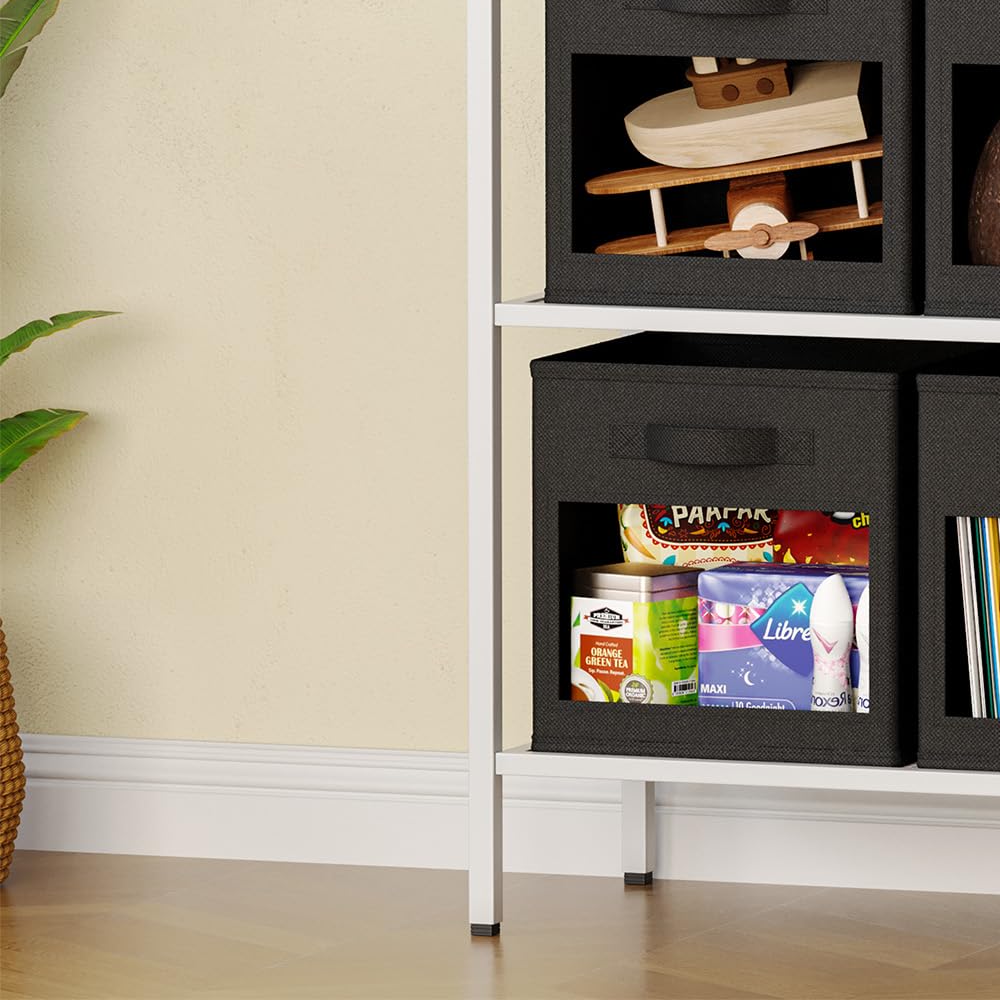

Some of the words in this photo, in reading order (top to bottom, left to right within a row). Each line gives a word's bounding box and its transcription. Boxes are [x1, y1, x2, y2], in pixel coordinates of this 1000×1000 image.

[763, 617, 811, 641] Libre
[591, 647, 622, 658] ORANGE
[585, 655, 612, 667] GREEN
[613, 658, 629, 669] TEA
[700, 683, 727, 694] MAXI
